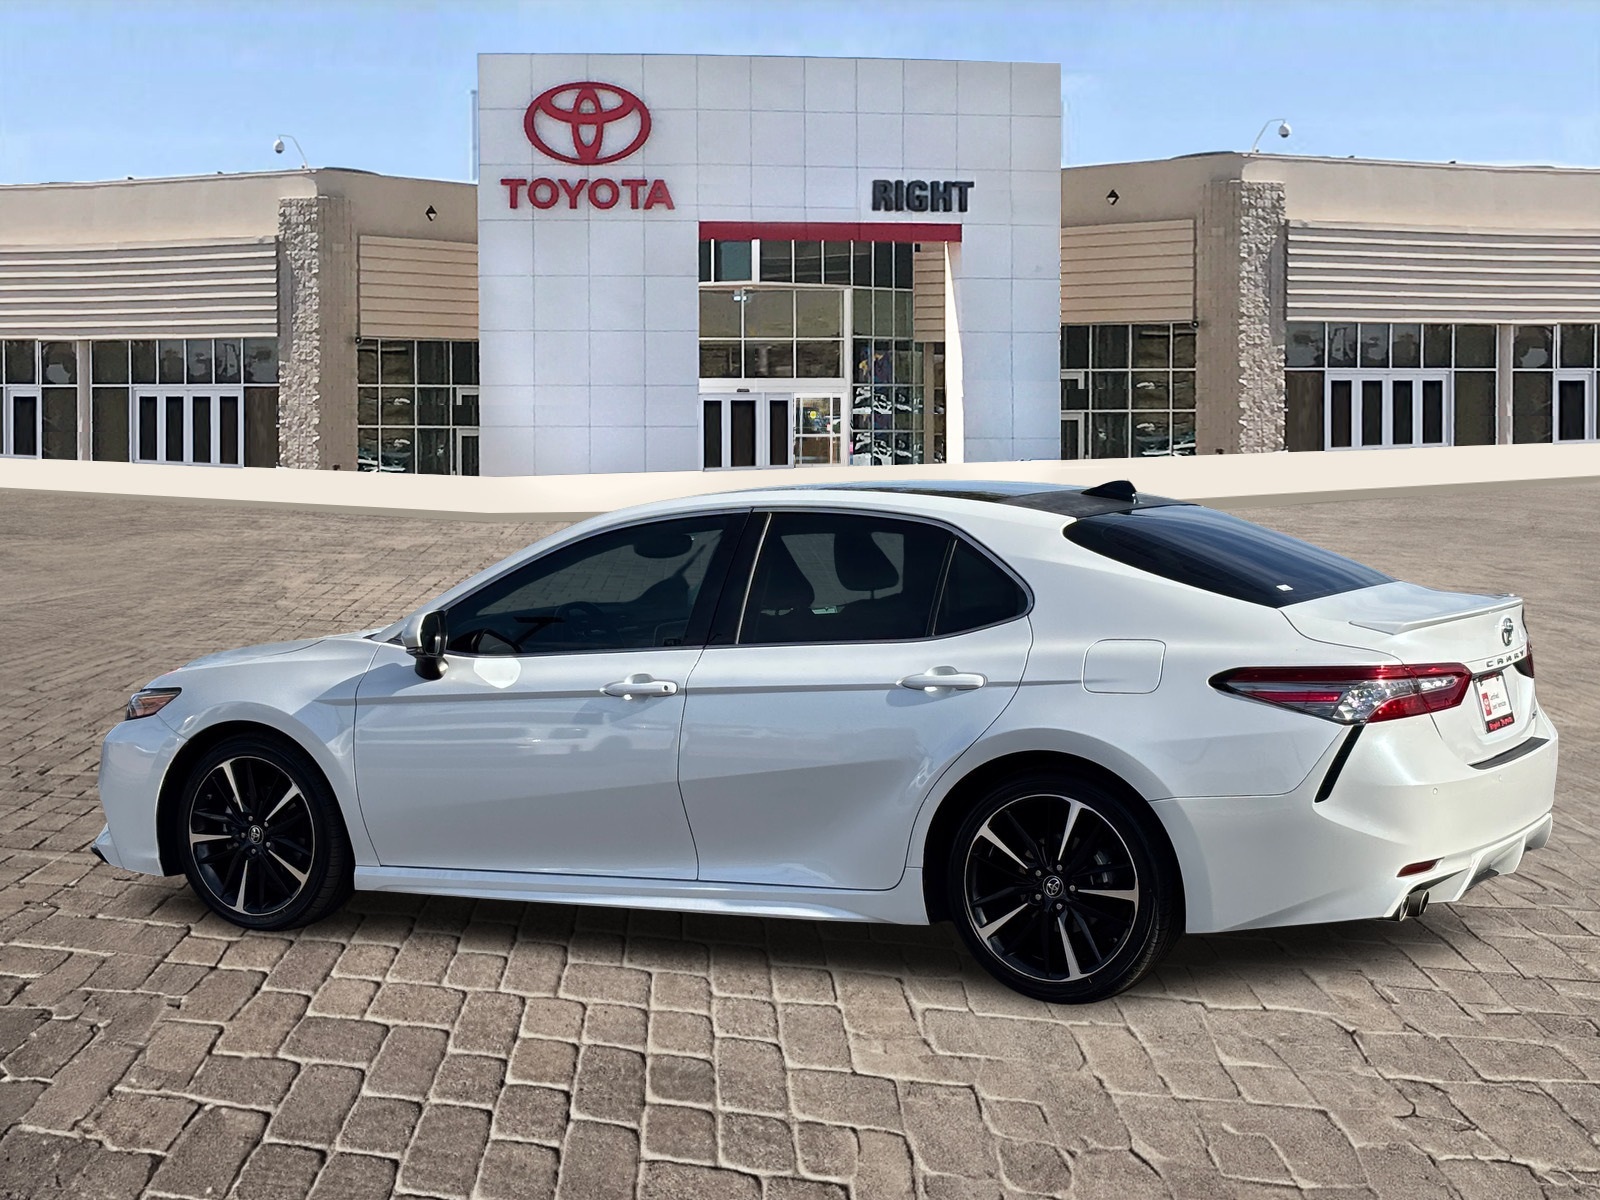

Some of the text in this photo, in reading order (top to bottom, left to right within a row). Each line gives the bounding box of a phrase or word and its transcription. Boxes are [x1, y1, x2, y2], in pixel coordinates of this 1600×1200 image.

[500, 178, 675, 210] TOYOTA
[872, 179, 975, 212] RIGHT
[1486, 650, 1524, 667] CAMRY
